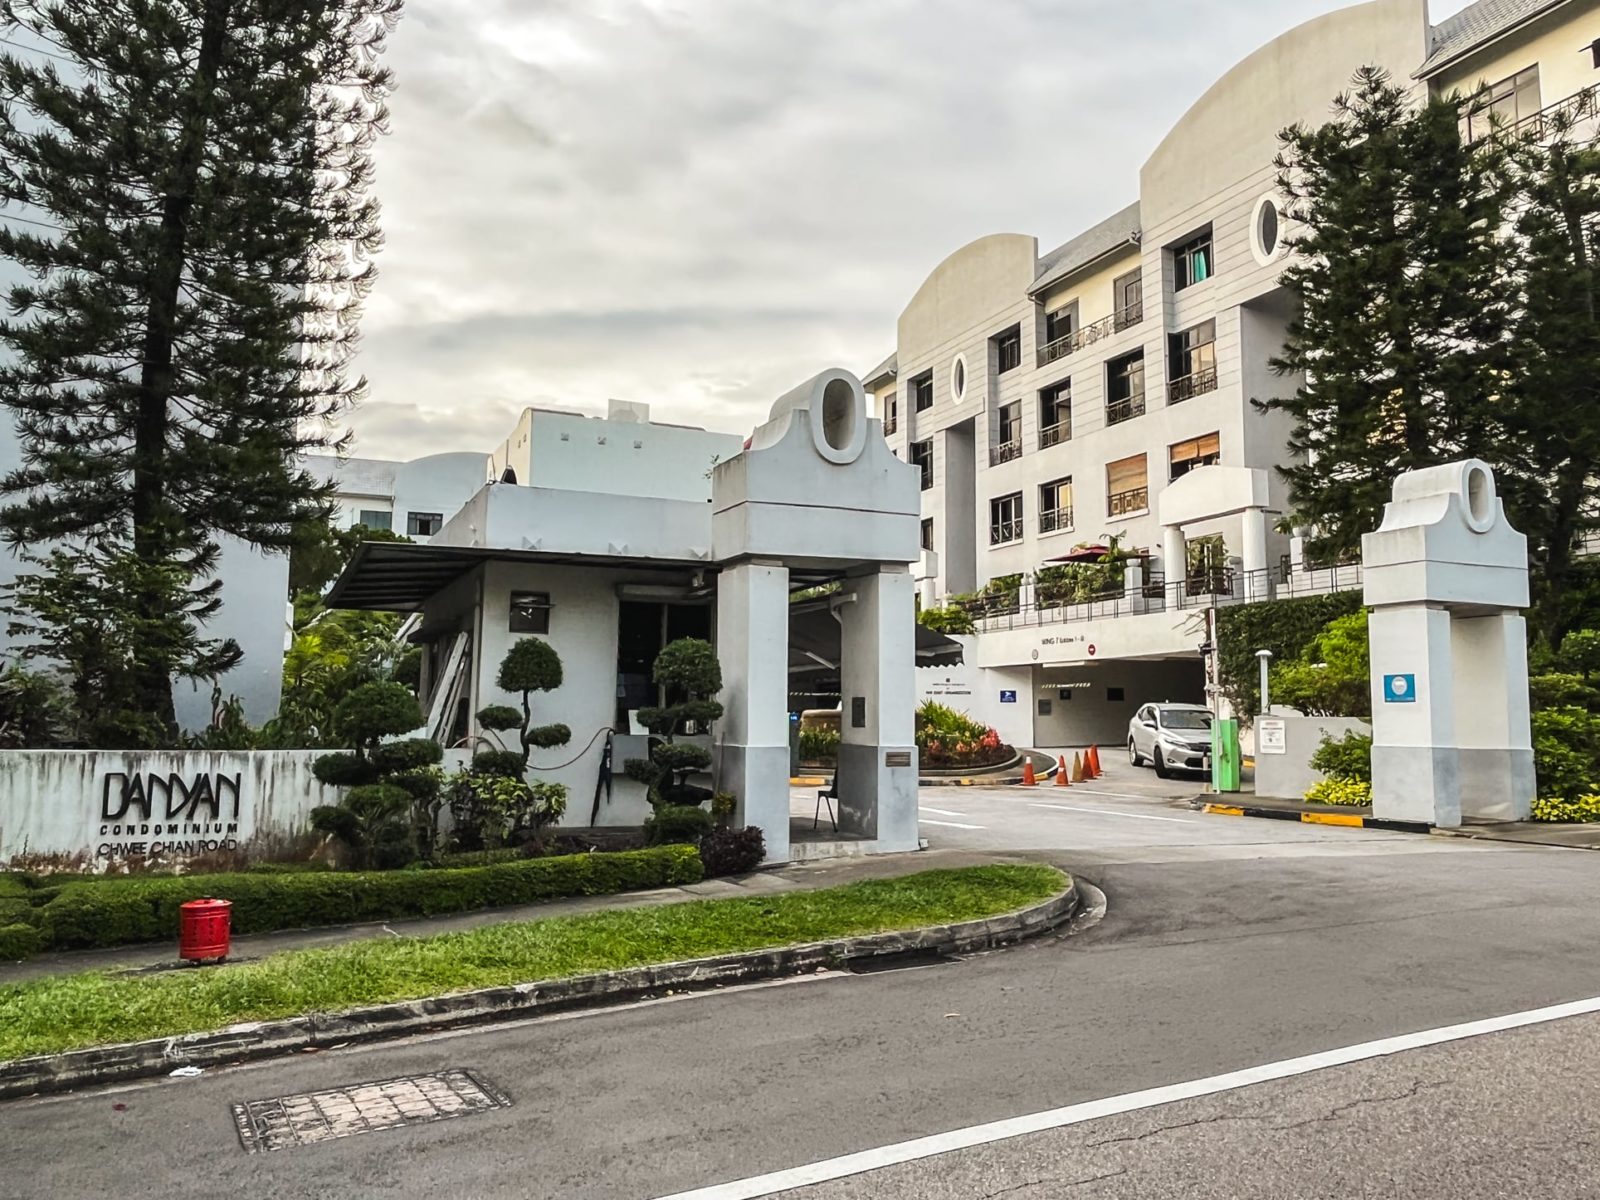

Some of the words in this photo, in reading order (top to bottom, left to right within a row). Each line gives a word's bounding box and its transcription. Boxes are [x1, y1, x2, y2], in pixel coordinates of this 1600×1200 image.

[100, 823, 238, 836] CONDOMINIUM
[98, 841, 148, 857] CHWEE
[150, 840, 195, 855] CHIAN
[198, 838, 237, 852] ROAD
